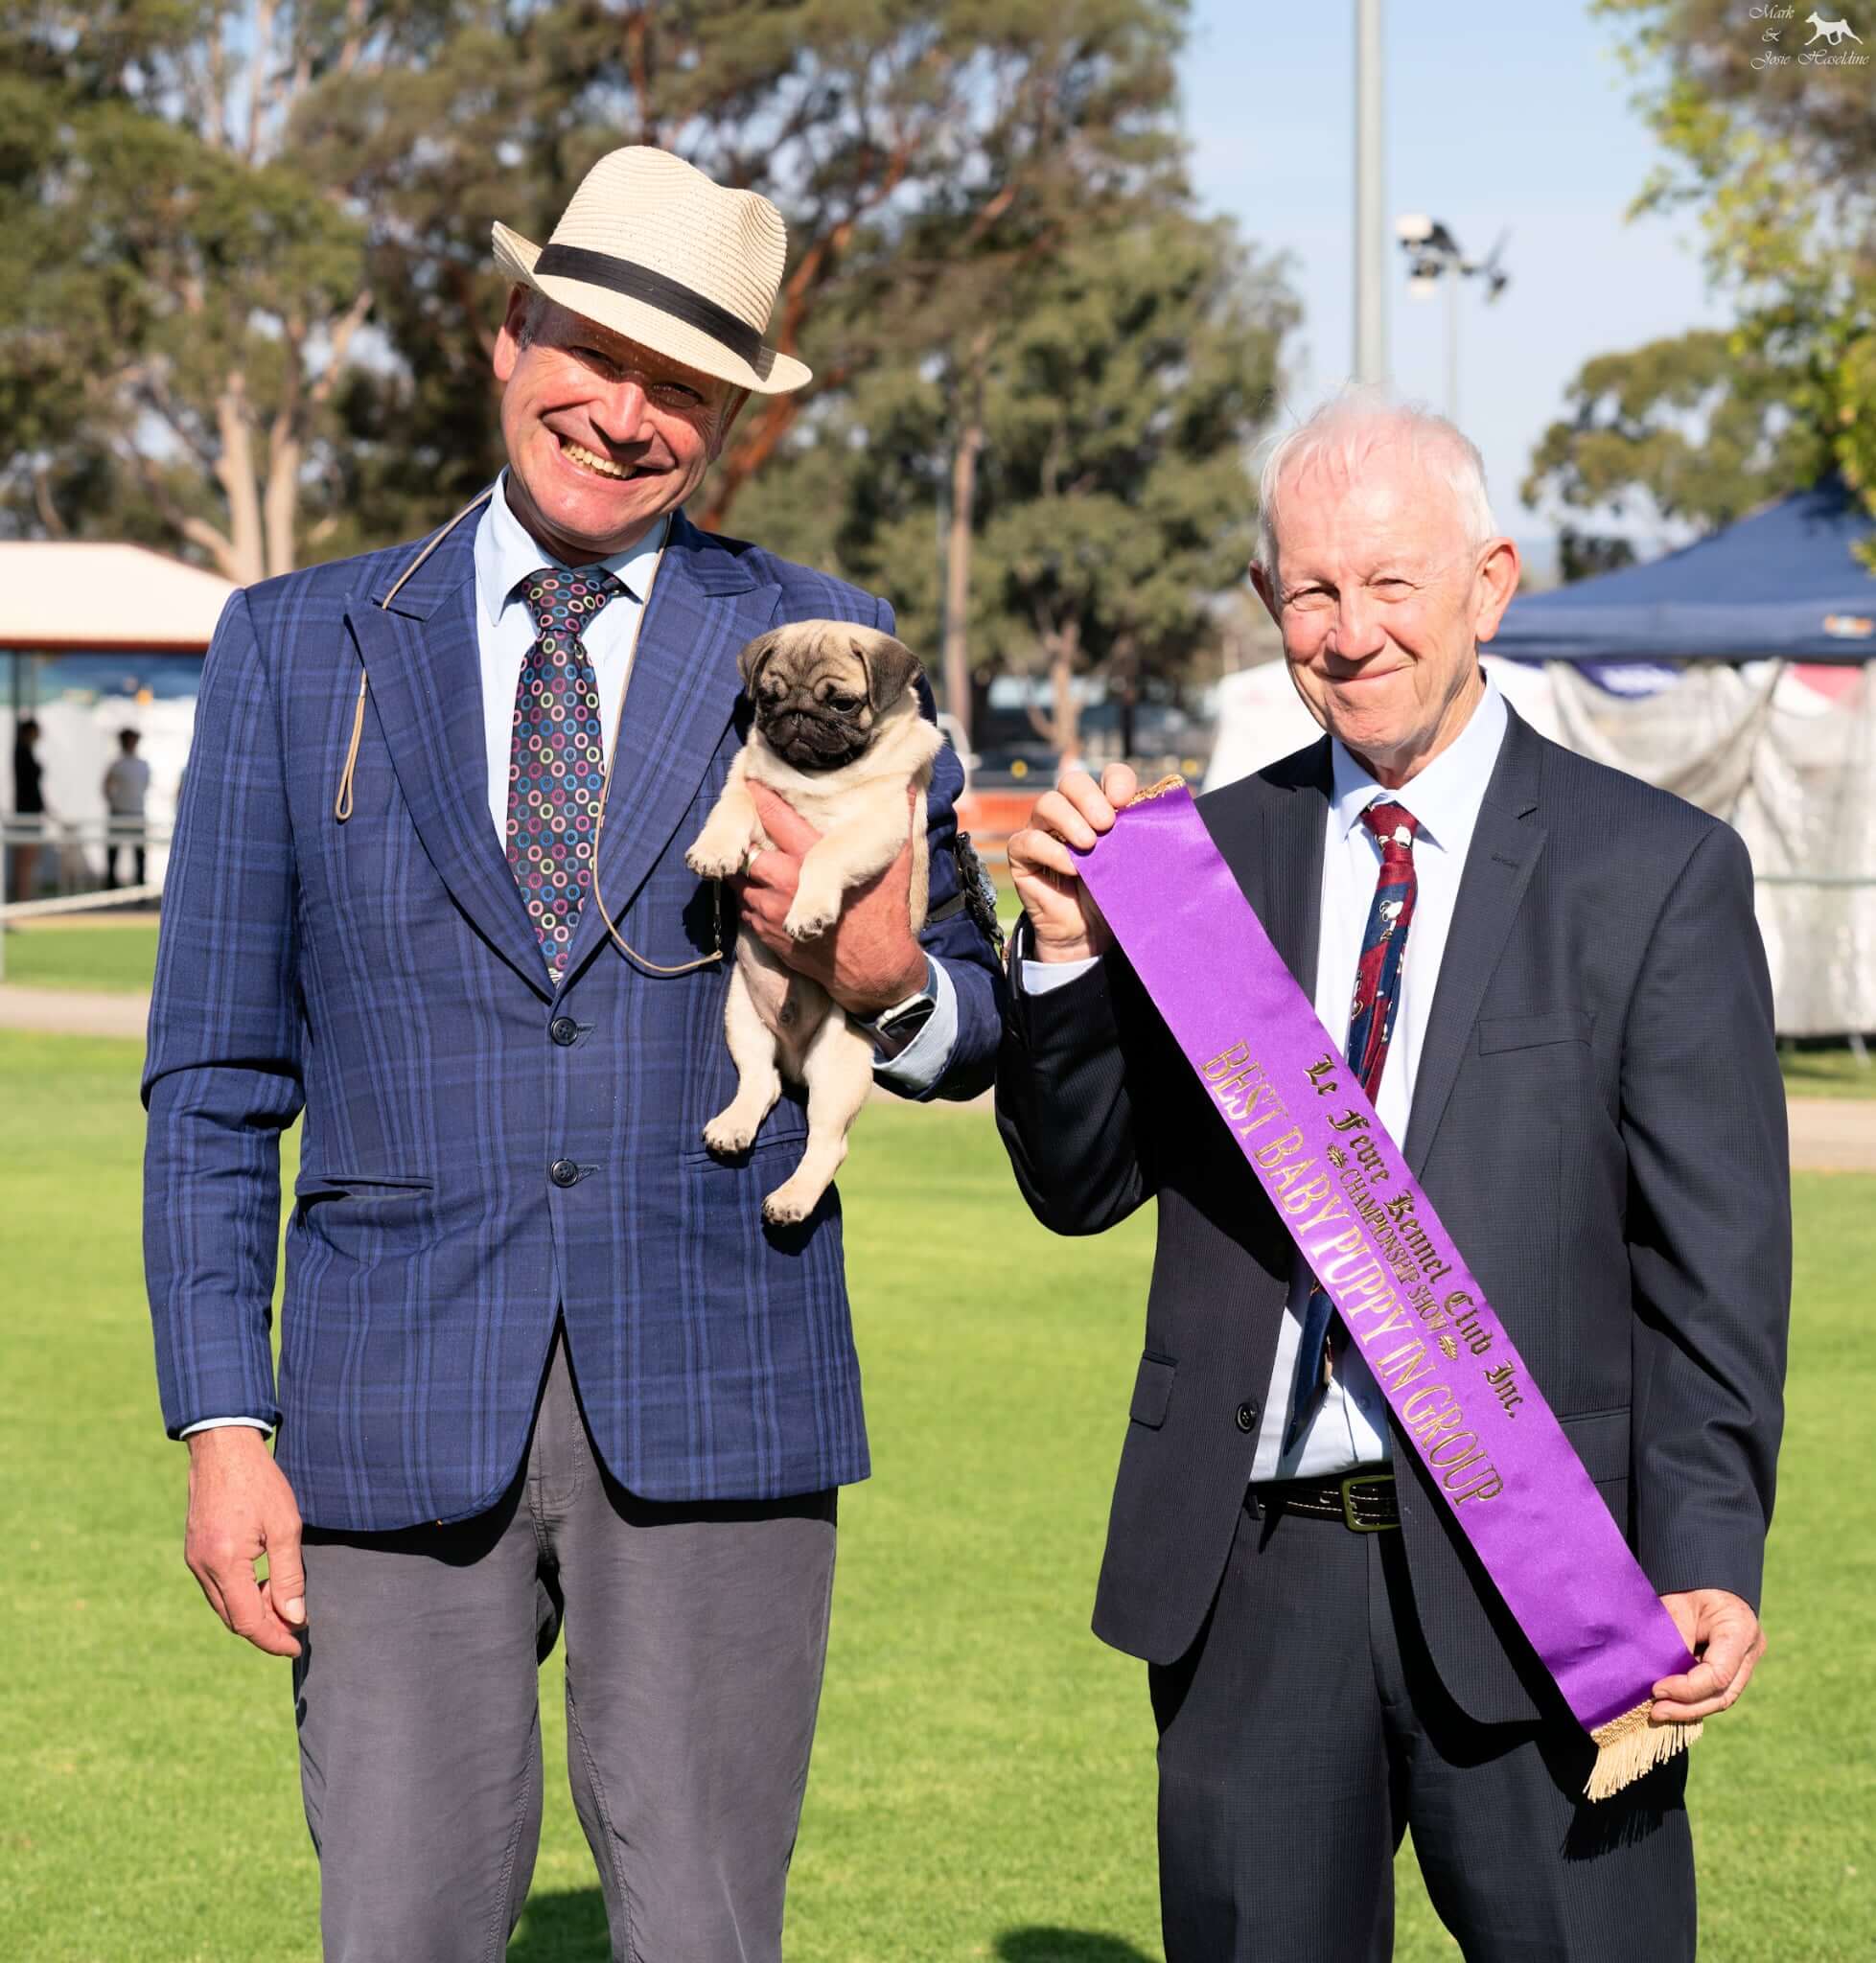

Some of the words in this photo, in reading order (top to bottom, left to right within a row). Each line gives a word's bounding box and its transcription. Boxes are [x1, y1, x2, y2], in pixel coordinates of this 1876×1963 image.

[1200, 1039, 1289, 1139] BEST
[1254, 1126, 1351, 1237] BABY
[1303, 1053, 1337, 1097] Le
[1326, 1109, 1389, 1185] Fevre
[1382, 1189, 1452, 1284] Kennel
[1444, 1291, 1493, 1355] Club
[1483, 1357, 1524, 1419] Inc.
[1310, 1225, 1414, 1345] PUPPY
[1340, 1167, 1420, 1285] CHAMPIONSHIP
[1406, 1284, 1448, 1334] SHOW
[1374, 1338, 1437, 1394] IN
[1402, 1383, 1504, 1508] GROUP
